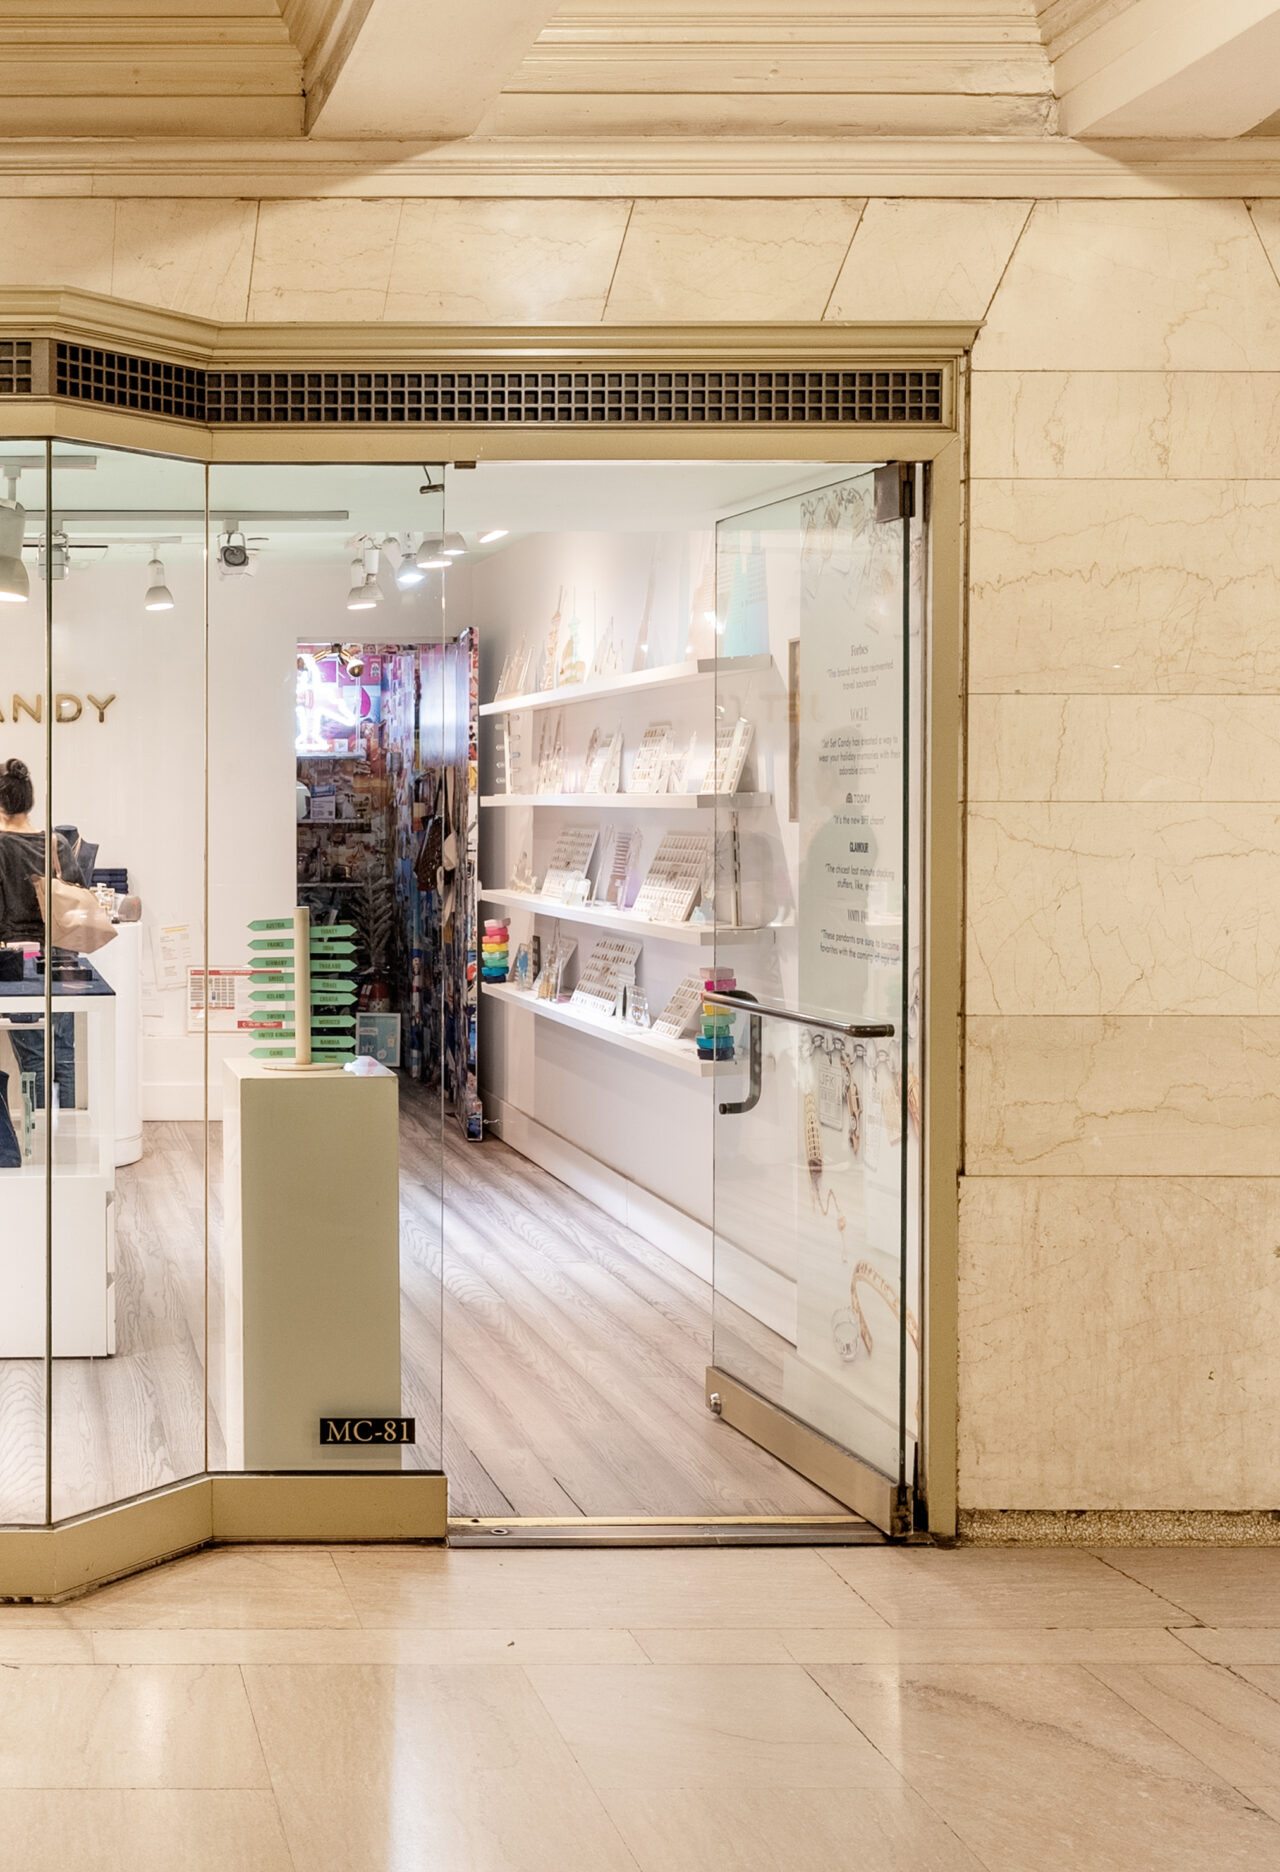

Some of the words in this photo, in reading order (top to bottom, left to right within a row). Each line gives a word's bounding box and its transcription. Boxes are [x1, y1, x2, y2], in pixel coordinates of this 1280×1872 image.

[850, 643, 869, 657] Forbes
[853, 793, 871, 804] TODAY
[326, 1420, 410, 1442] MC-81
